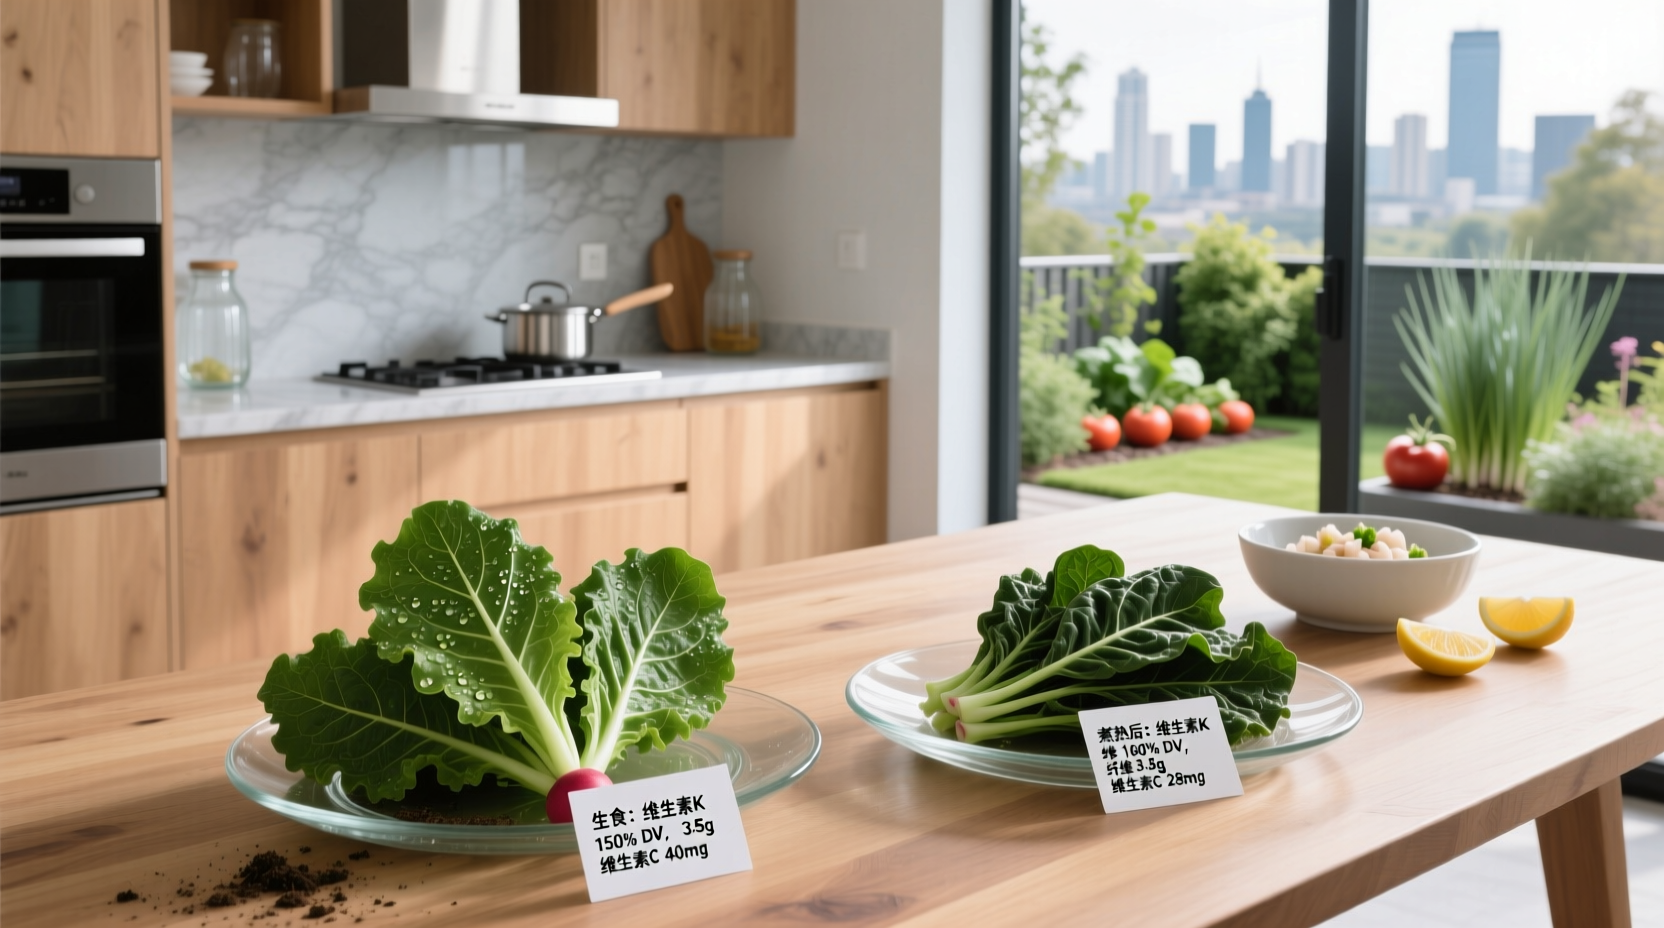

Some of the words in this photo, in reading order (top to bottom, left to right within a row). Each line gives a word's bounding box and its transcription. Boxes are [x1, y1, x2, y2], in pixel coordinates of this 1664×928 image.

[1136, 758, 1167, 774] 3.5g
[1167, 772, 1206, 787] 28mg
[594, 832, 637, 852] 150%
[681, 818, 715, 836] 3.5g
[664, 843, 709, 862] 40mg
